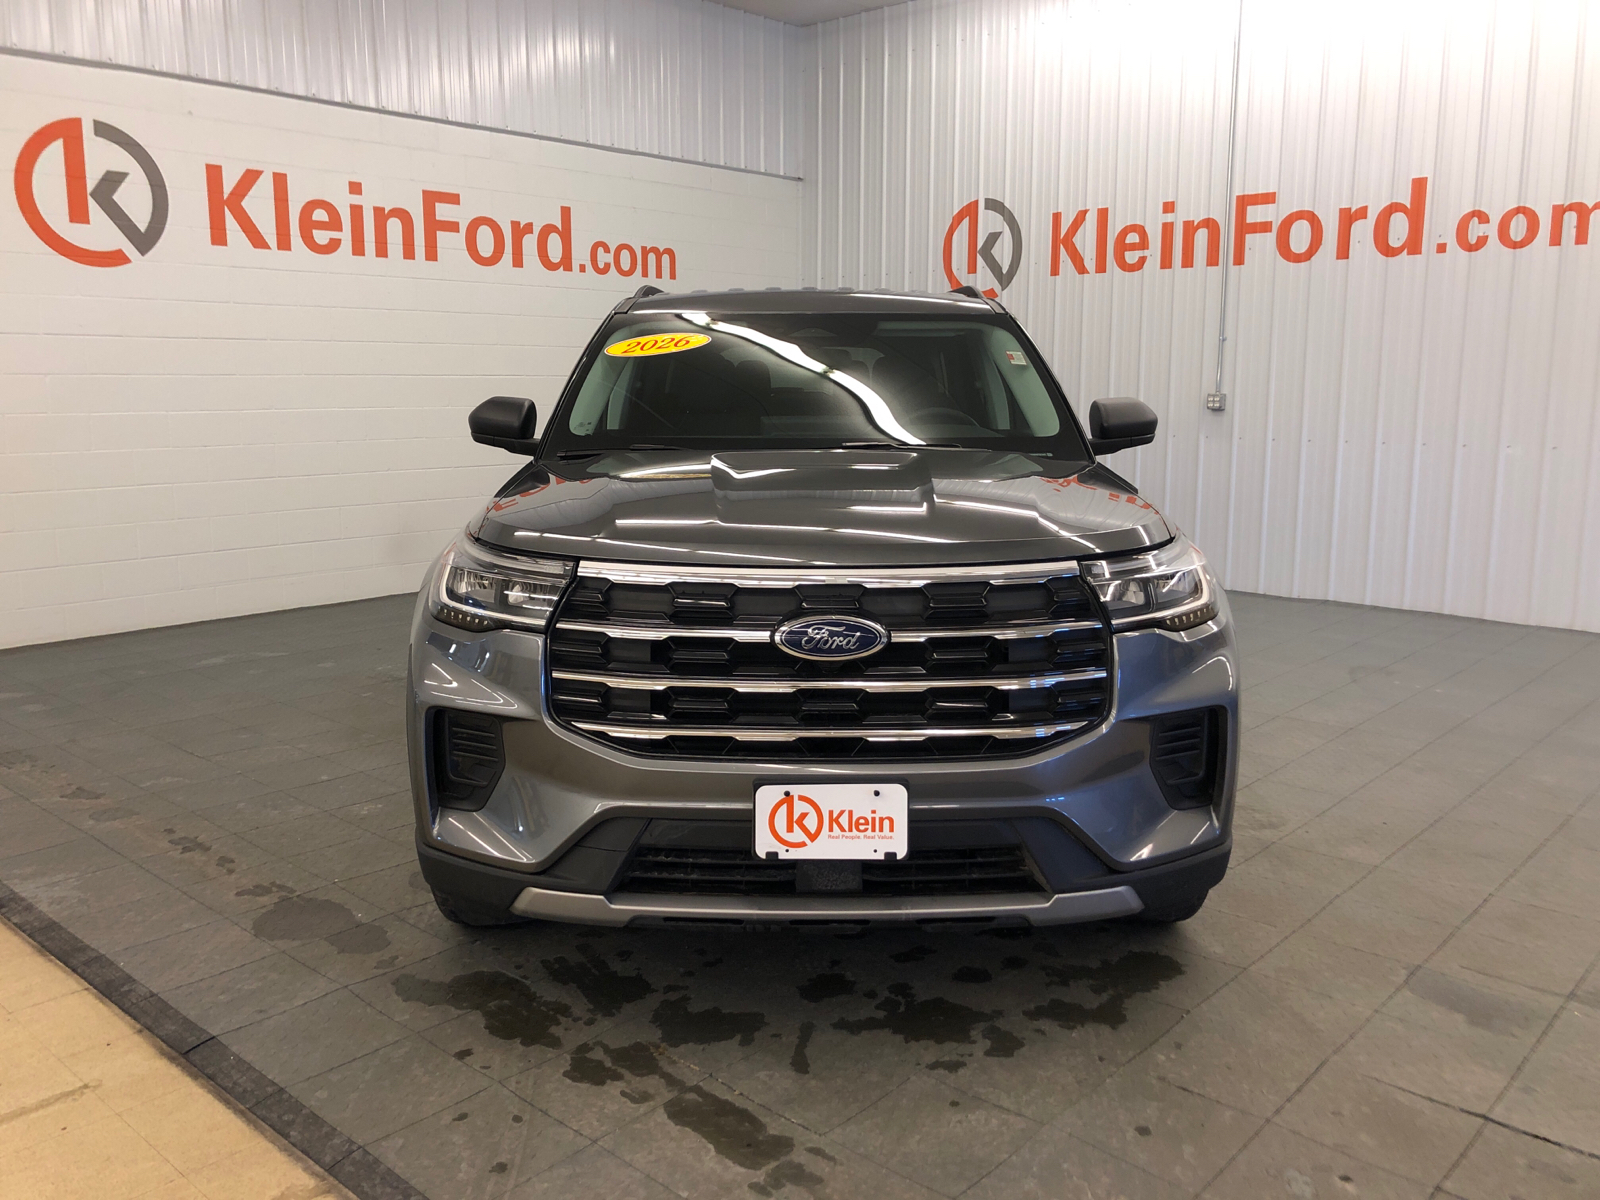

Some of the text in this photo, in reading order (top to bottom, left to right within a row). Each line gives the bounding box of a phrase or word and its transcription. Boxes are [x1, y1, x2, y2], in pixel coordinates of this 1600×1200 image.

[204, 162, 677, 281] KleinFord.com
[1049, 175, 1600, 277] KleinFord.com
[620, 335, 694, 354] 2026
[801, 624, 860, 650] Ford
[828, 809, 895, 833] Klein
